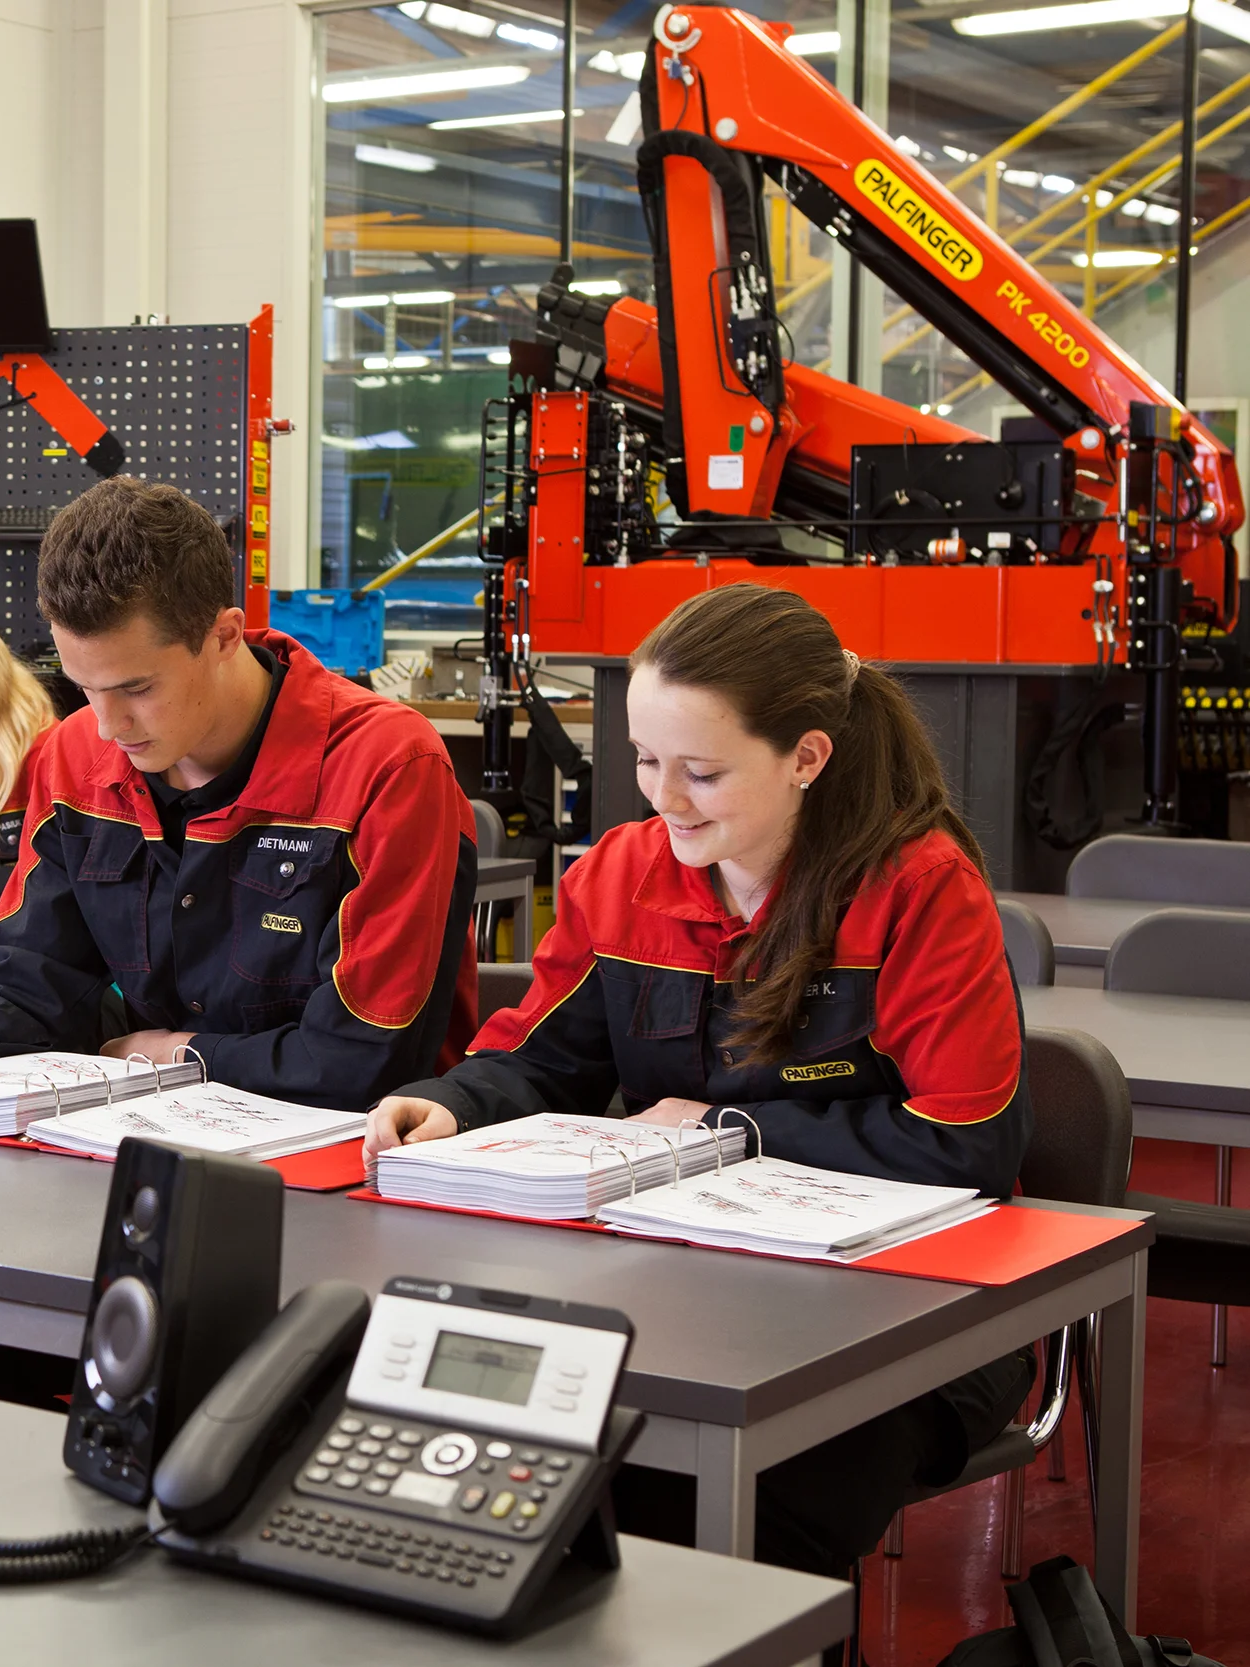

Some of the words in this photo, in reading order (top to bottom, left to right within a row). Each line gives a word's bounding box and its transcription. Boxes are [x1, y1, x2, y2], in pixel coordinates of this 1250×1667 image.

[862, 168, 973, 272] PALFINGER
[996, 279, 1032, 316] PK
[1027, 312, 1090, 369] 4200
[823, 983, 836, 995] K.
[785, 1064, 851, 1080] PALFINGER
